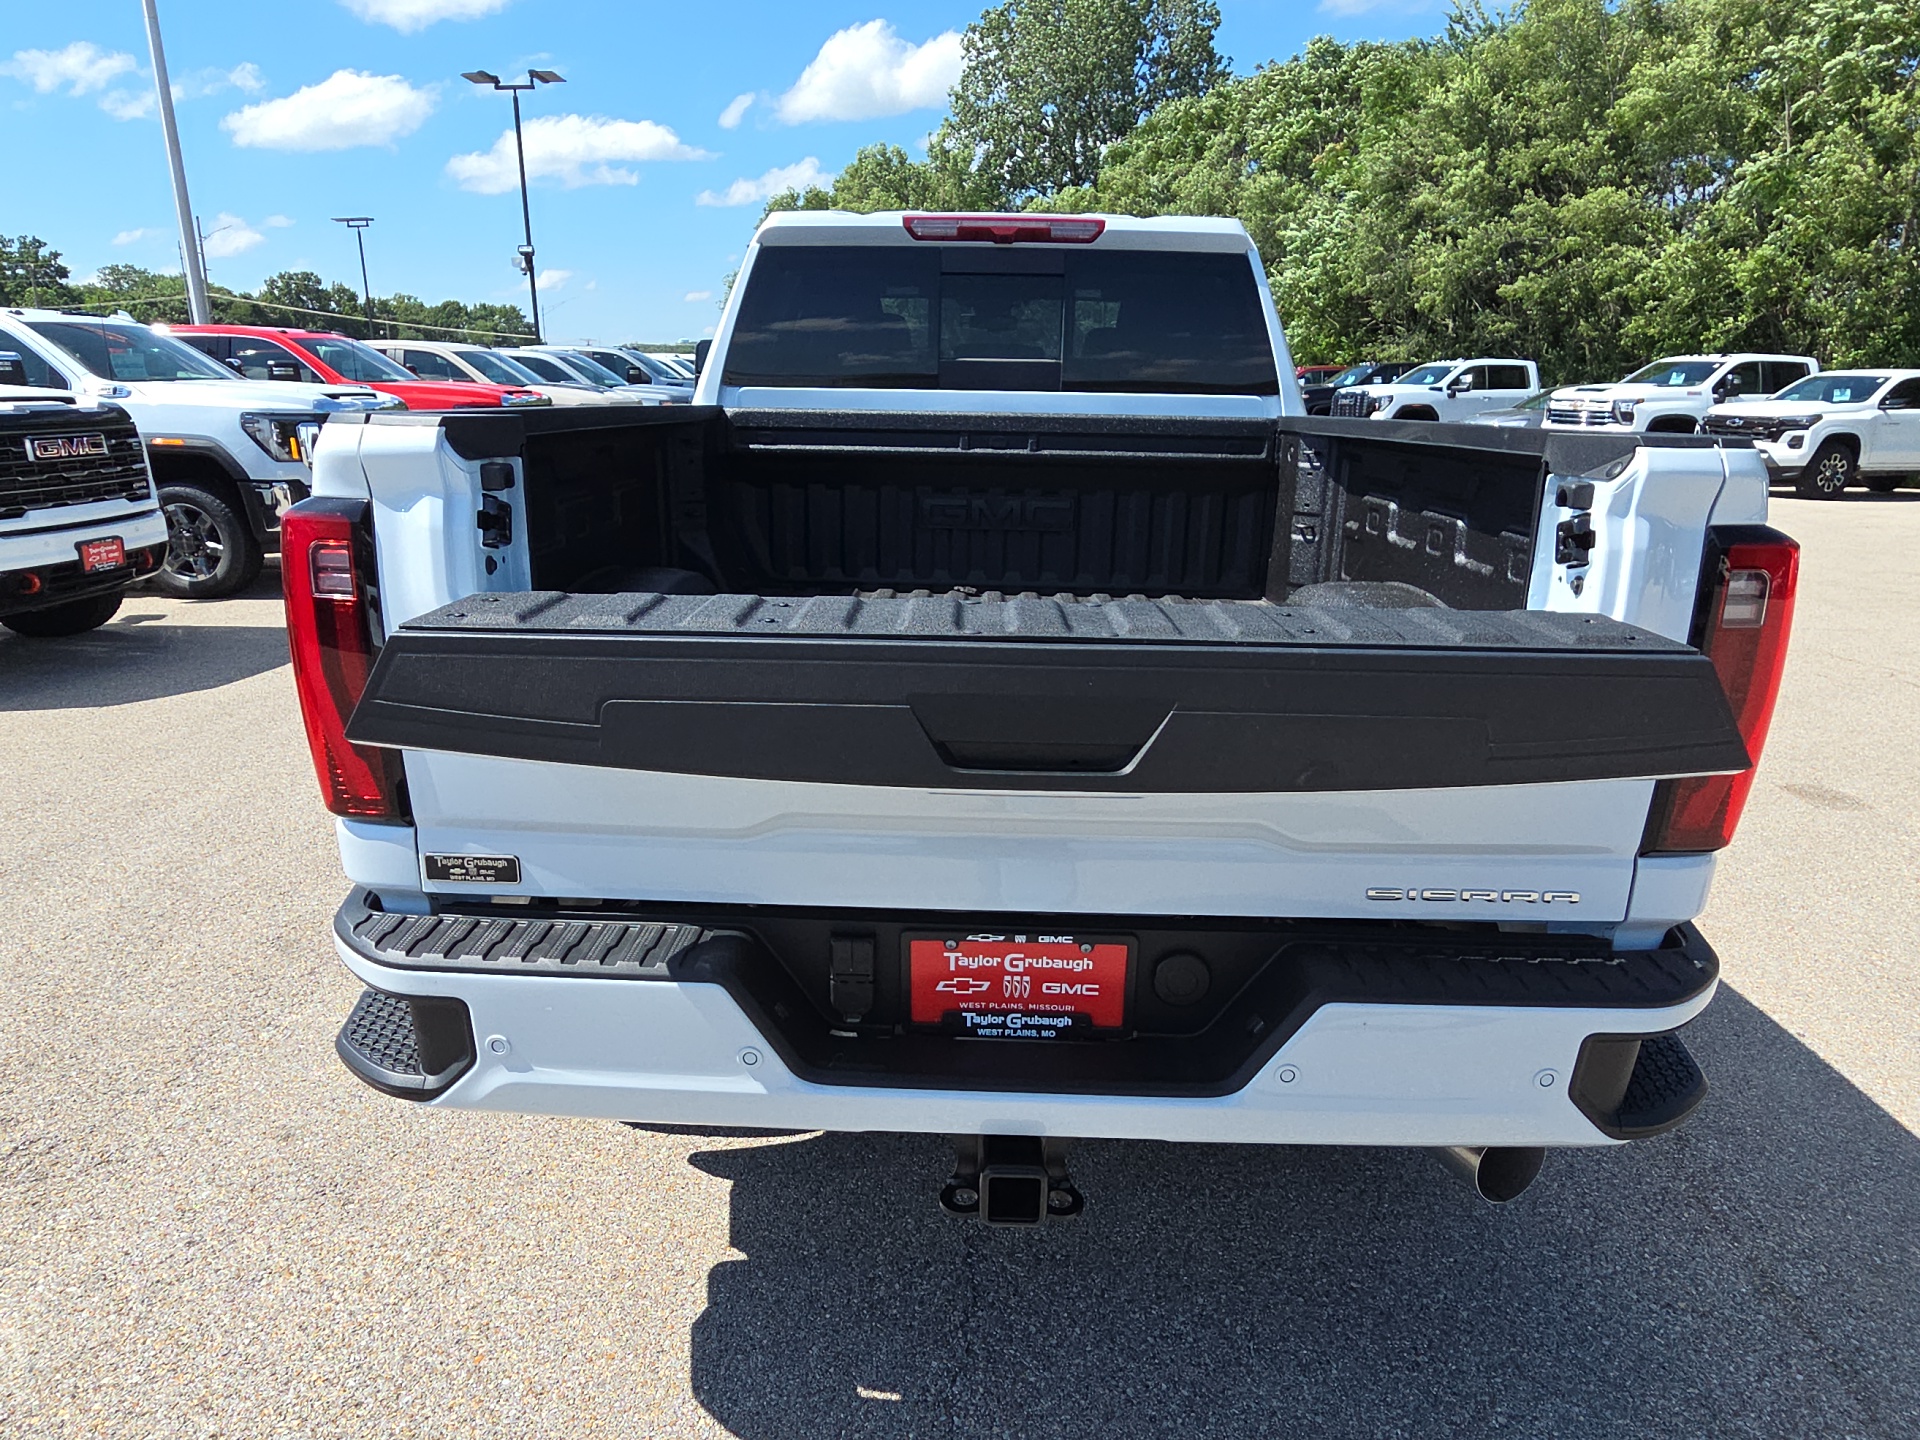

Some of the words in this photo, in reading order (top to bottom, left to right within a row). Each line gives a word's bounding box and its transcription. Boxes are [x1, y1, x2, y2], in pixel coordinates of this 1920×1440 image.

[34, 437, 106, 458] GMC
[921, 498, 1073, 530] GMC
[434, 856, 463, 867] Taylor
[464, 857, 508, 868] Grubaugh
[1366, 887, 1580, 903] SIERRA
[1038, 935, 1074, 944] GMC
[943, 952, 1001, 971] Taylor
[1003, 953, 1093, 972] Grubaugh
[1042, 982, 1100, 996] GMC
[959, 1002, 986, 1010] WEST
[989, 1002, 1026, 1011] PLAINS,
[1028, 1003, 1075, 1012] MISSOURI
[962, 1012, 1005, 1027] Taylor
[1006, 1013, 1072, 1028] Grubaugh
[977, 1028, 1003, 1037] WEST
[1004, 1028, 1040, 1038] PLAINS,
[1041, 1029, 1056, 1038] MO
